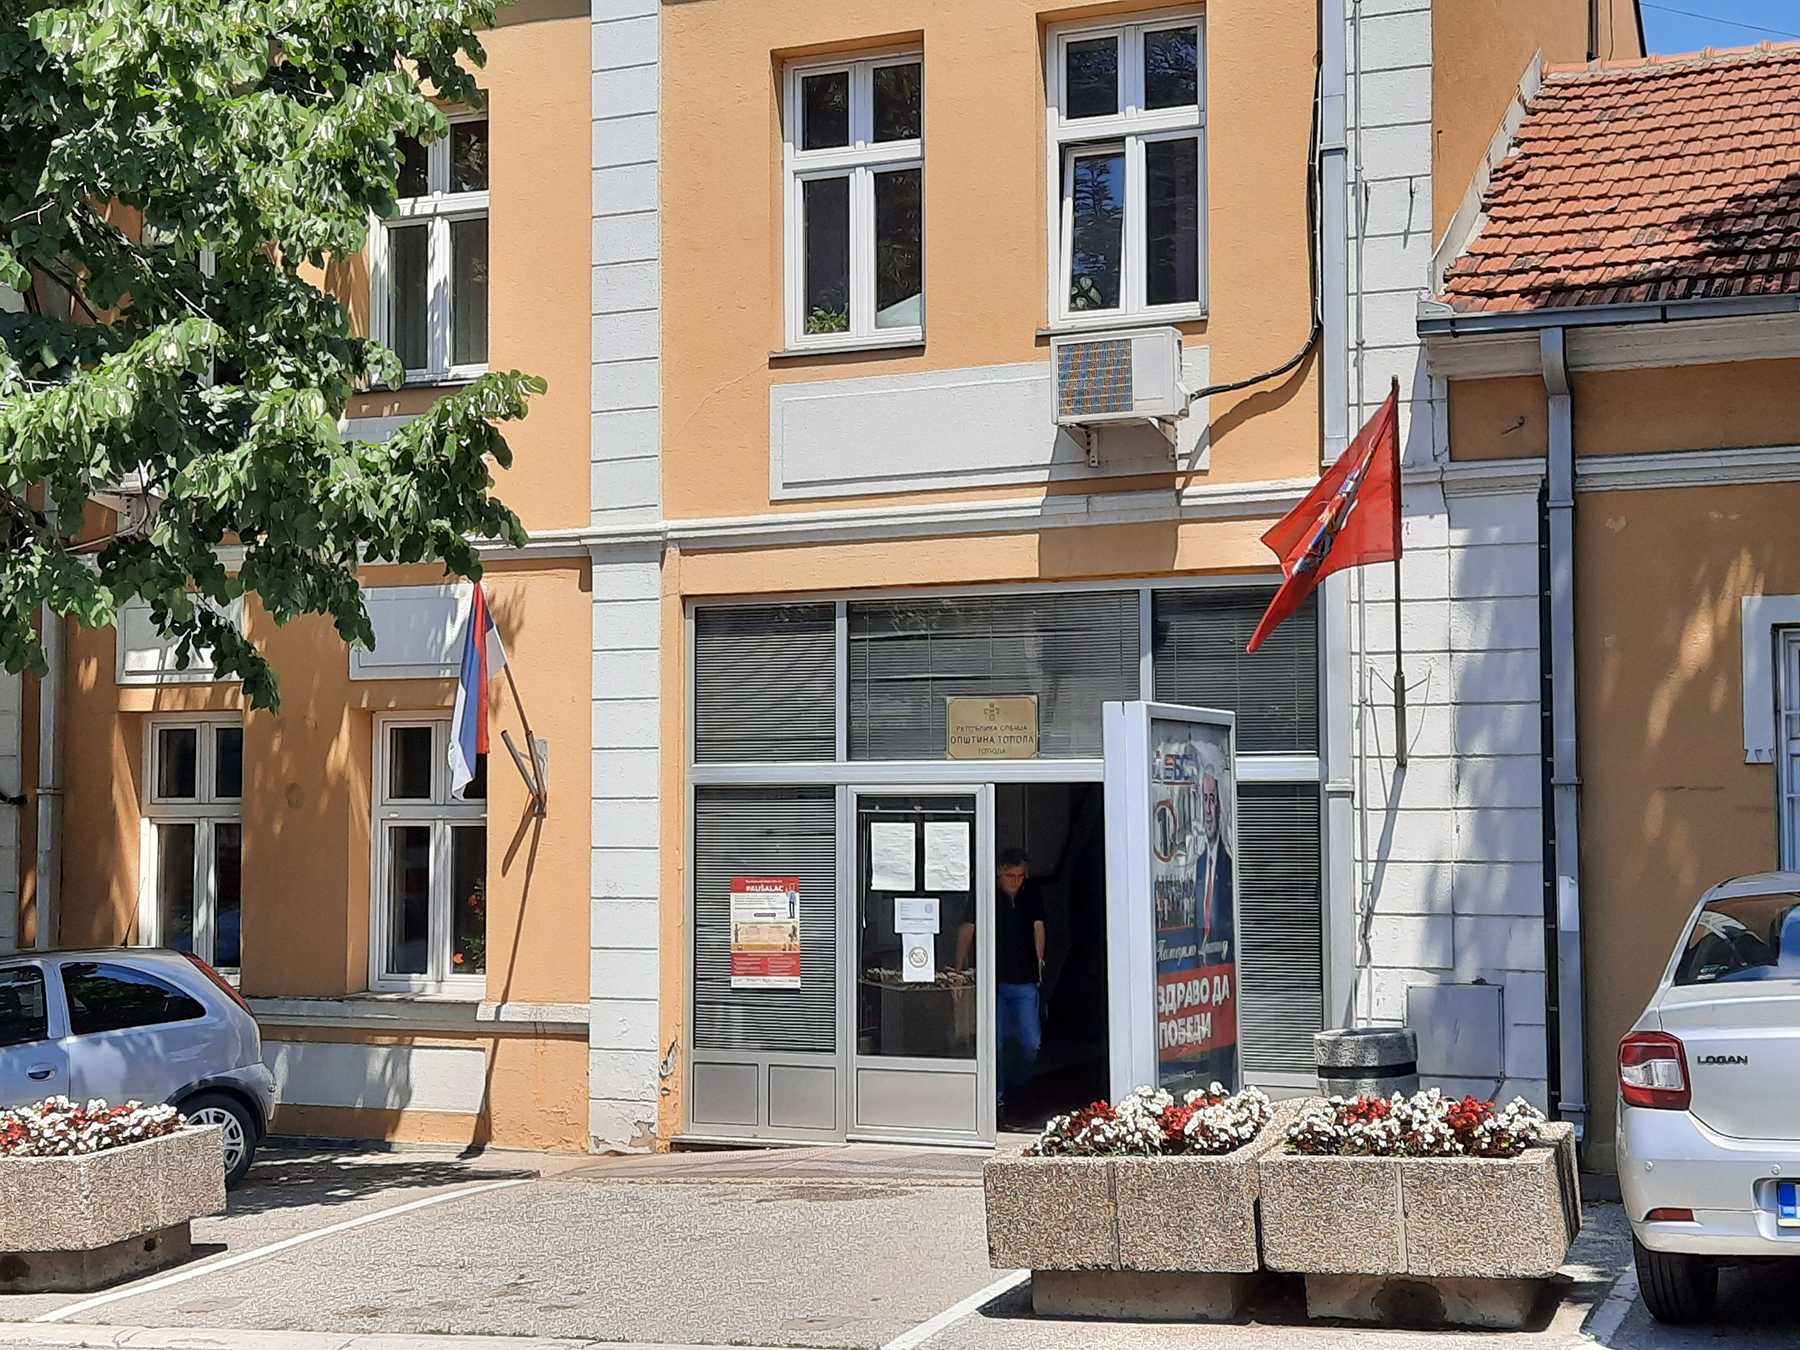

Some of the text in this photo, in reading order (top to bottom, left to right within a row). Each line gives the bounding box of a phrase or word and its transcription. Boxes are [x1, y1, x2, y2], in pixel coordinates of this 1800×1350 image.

[950, 735, 1034, 745] ОПШТИНА ТОПОЛА
[1157, 974, 1231, 1016] ЗДРАВО ДА
[1158, 1011, 1213, 1050] ПОБЕДИ
[1697, 1055, 1749, 1065] LOGAN
